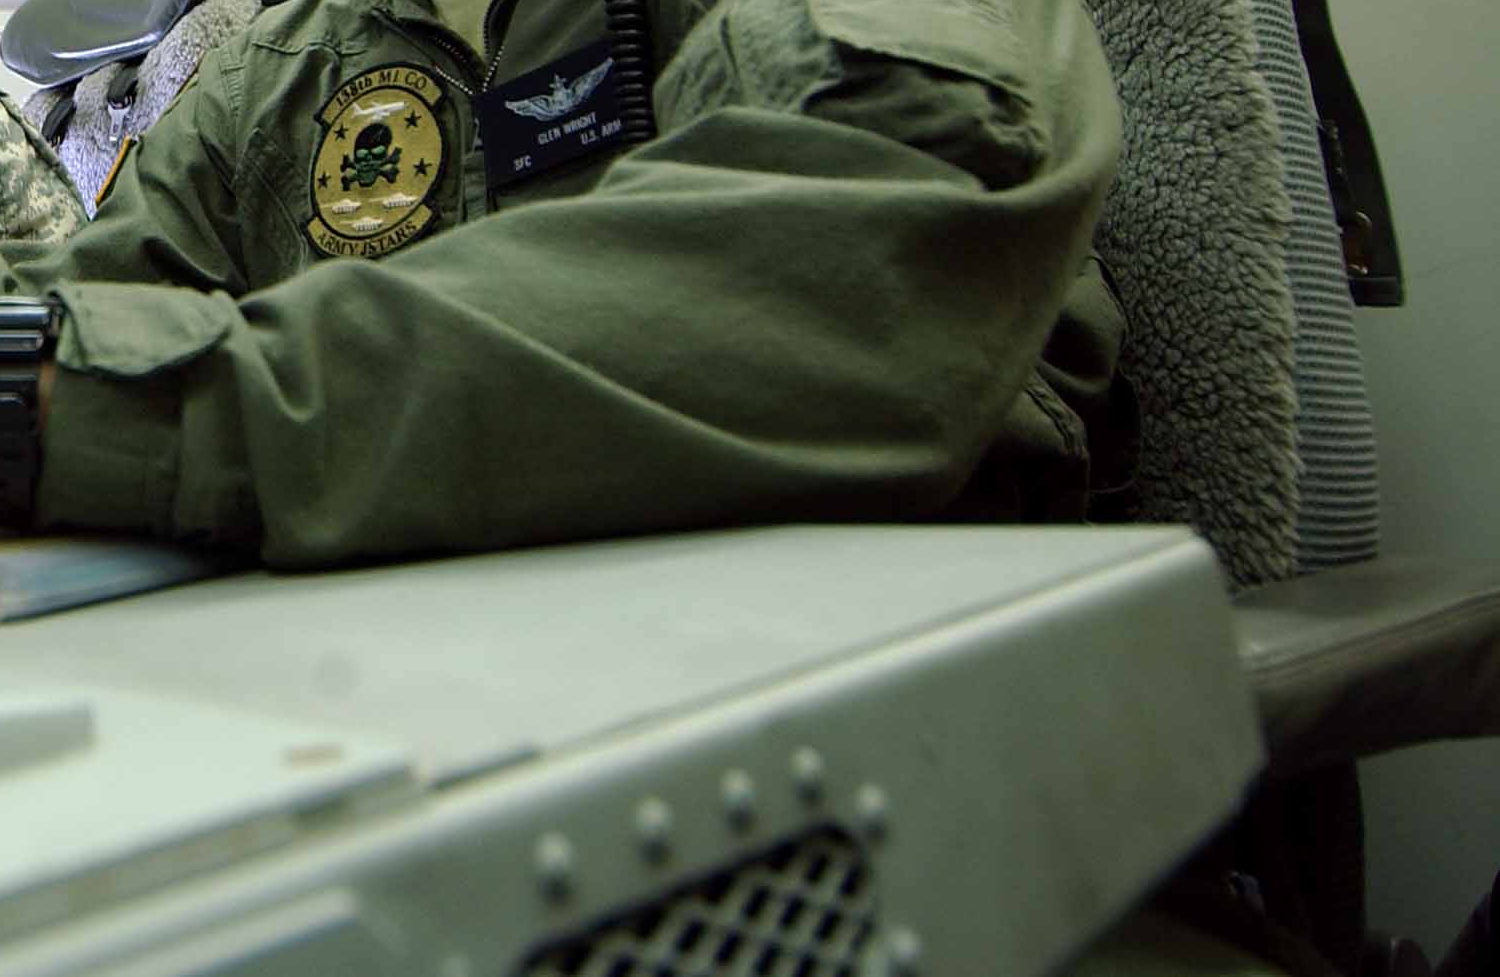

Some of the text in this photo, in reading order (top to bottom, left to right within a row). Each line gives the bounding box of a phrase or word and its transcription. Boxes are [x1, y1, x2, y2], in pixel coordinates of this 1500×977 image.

[379, 70, 399, 83] MI
[405, 71, 428, 91] CO
[513, 155, 532, 171] SFC
[319, 233, 357, 255] ARMY
